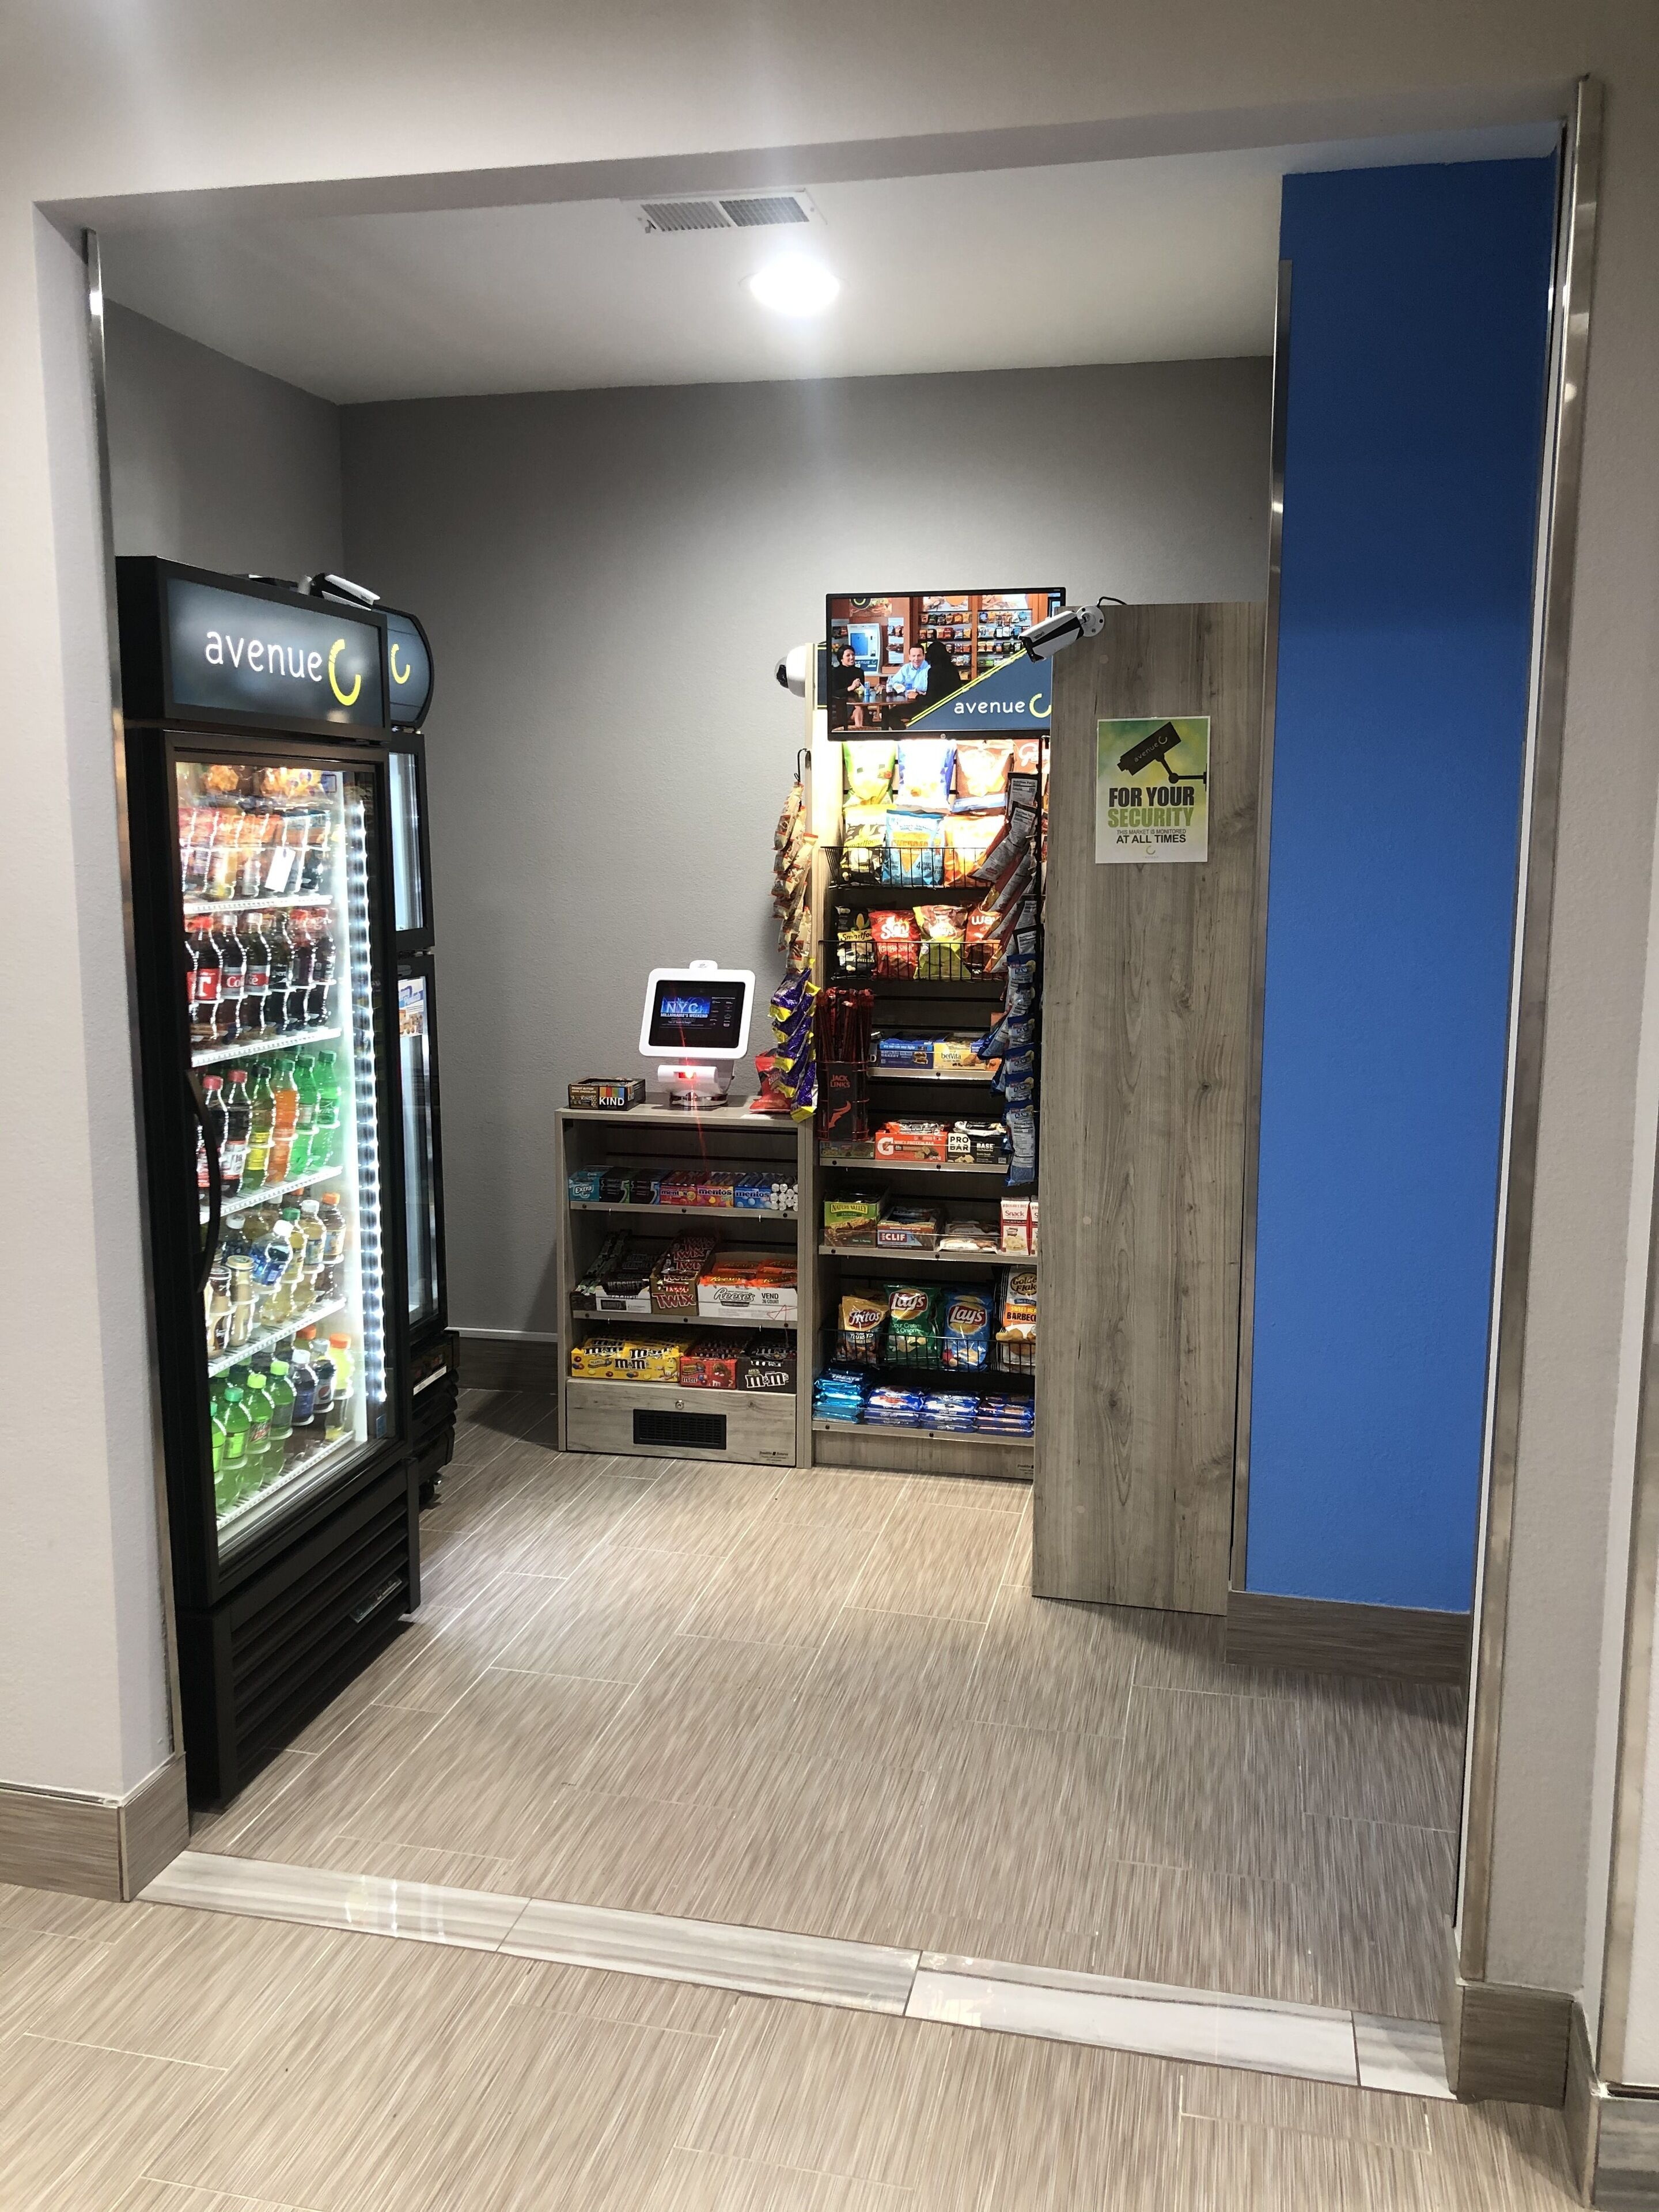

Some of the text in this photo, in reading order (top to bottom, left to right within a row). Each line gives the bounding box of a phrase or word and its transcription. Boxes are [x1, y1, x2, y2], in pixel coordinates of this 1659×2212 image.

[205, 631, 323, 682] avenue
[954, 700, 1025, 714] avenue
[1133, 741, 1159, 763] avenue
[1109, 786, 1194, 807] FOR YOUR
[1107, 807, 1194, 828] SECURITY
[1116, 834, 1187, 844] AT ALL TIMES
[599, 1097, 624, 1106] KIND
[575, 1185, 592, 1194] Extra
[736, 1190, 770, 1198] mentos
[831, 1203, 867, 1213] NATURE VALLEY
[885, 1233, 906, 1241] CLIF
[714, 1287, 756, 1302] Reese's
[891, 1292, 926, 1312] Lay's
[849, 1308, 881, 1325] Fritos
[949, 1306, 984, 1324] Lay's
[745, 1372, 789, 1388] m&m's
